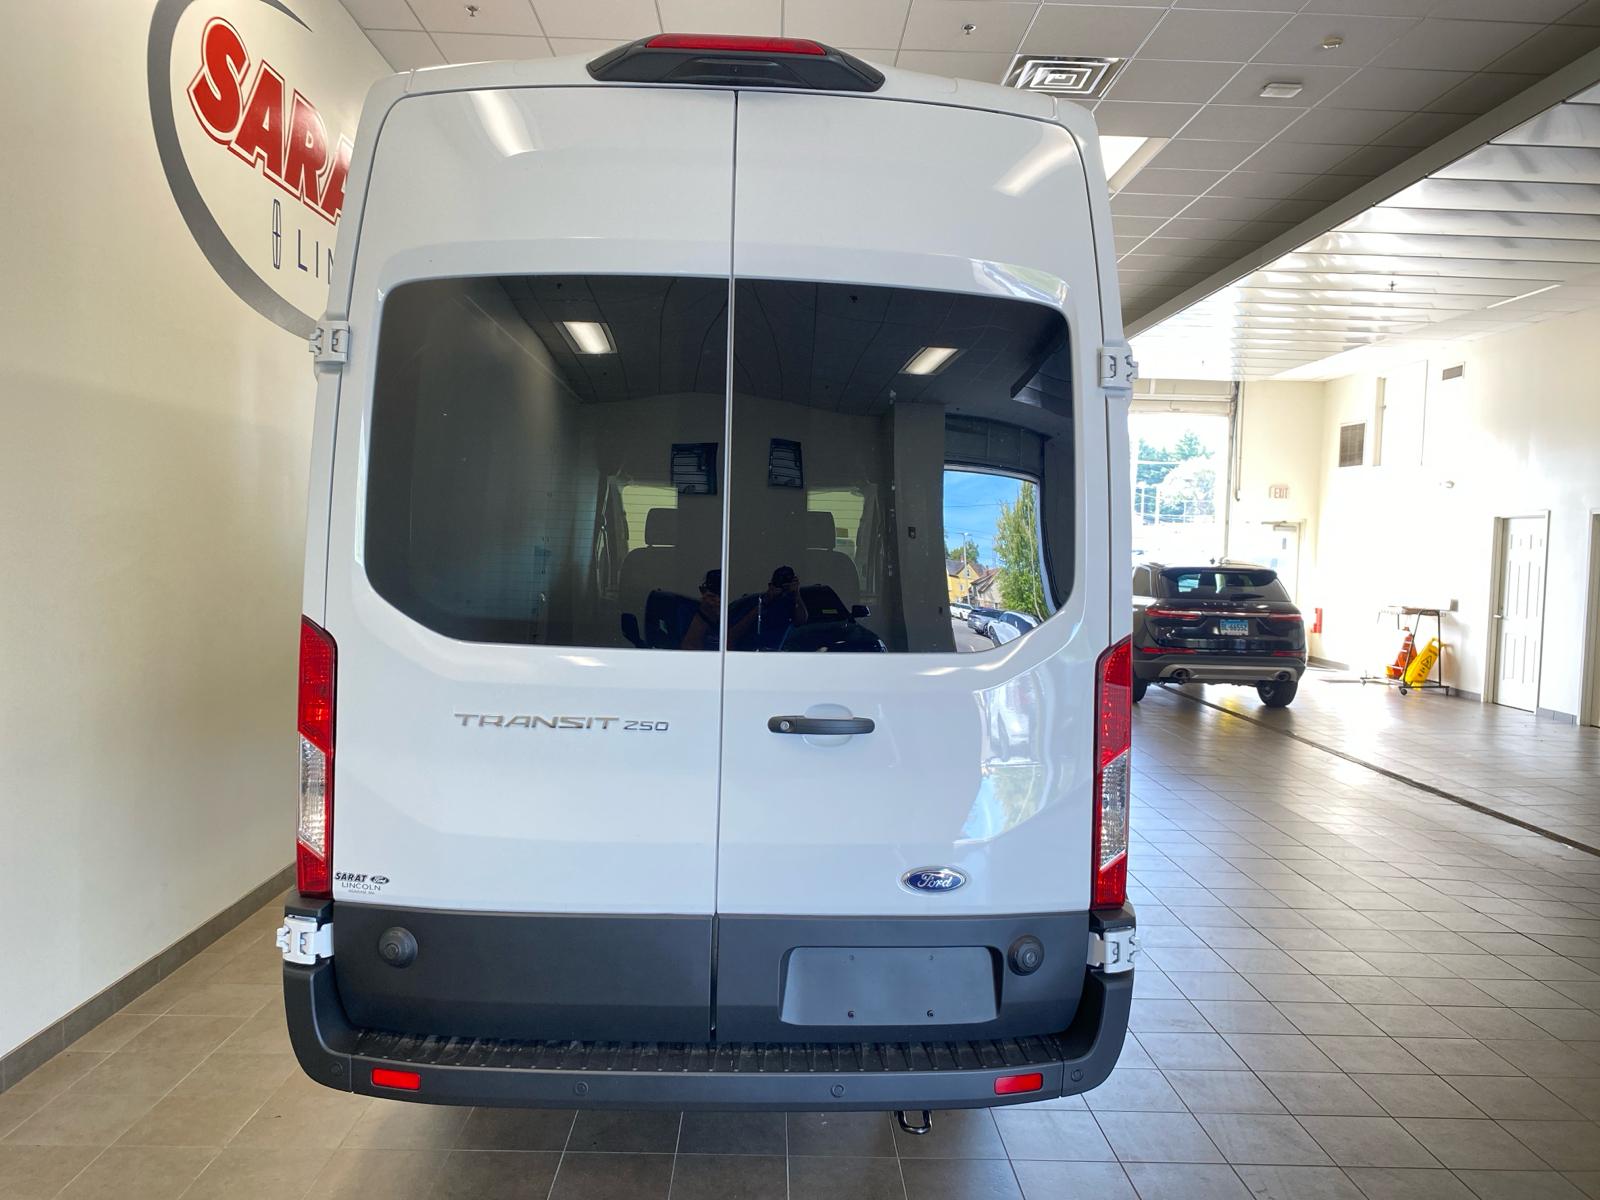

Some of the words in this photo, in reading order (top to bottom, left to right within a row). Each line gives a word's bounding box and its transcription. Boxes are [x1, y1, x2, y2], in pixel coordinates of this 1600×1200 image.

[1274, 487, 1288, 499] EXIT
[454, 713, 619, 730] TRANSIT
[623, 720, 669, 731] 250
[334, 872, 367, 882] SARAT
[917, 873, 953, 888] Ford
[341, 882, 381, 891] LINCOLN
